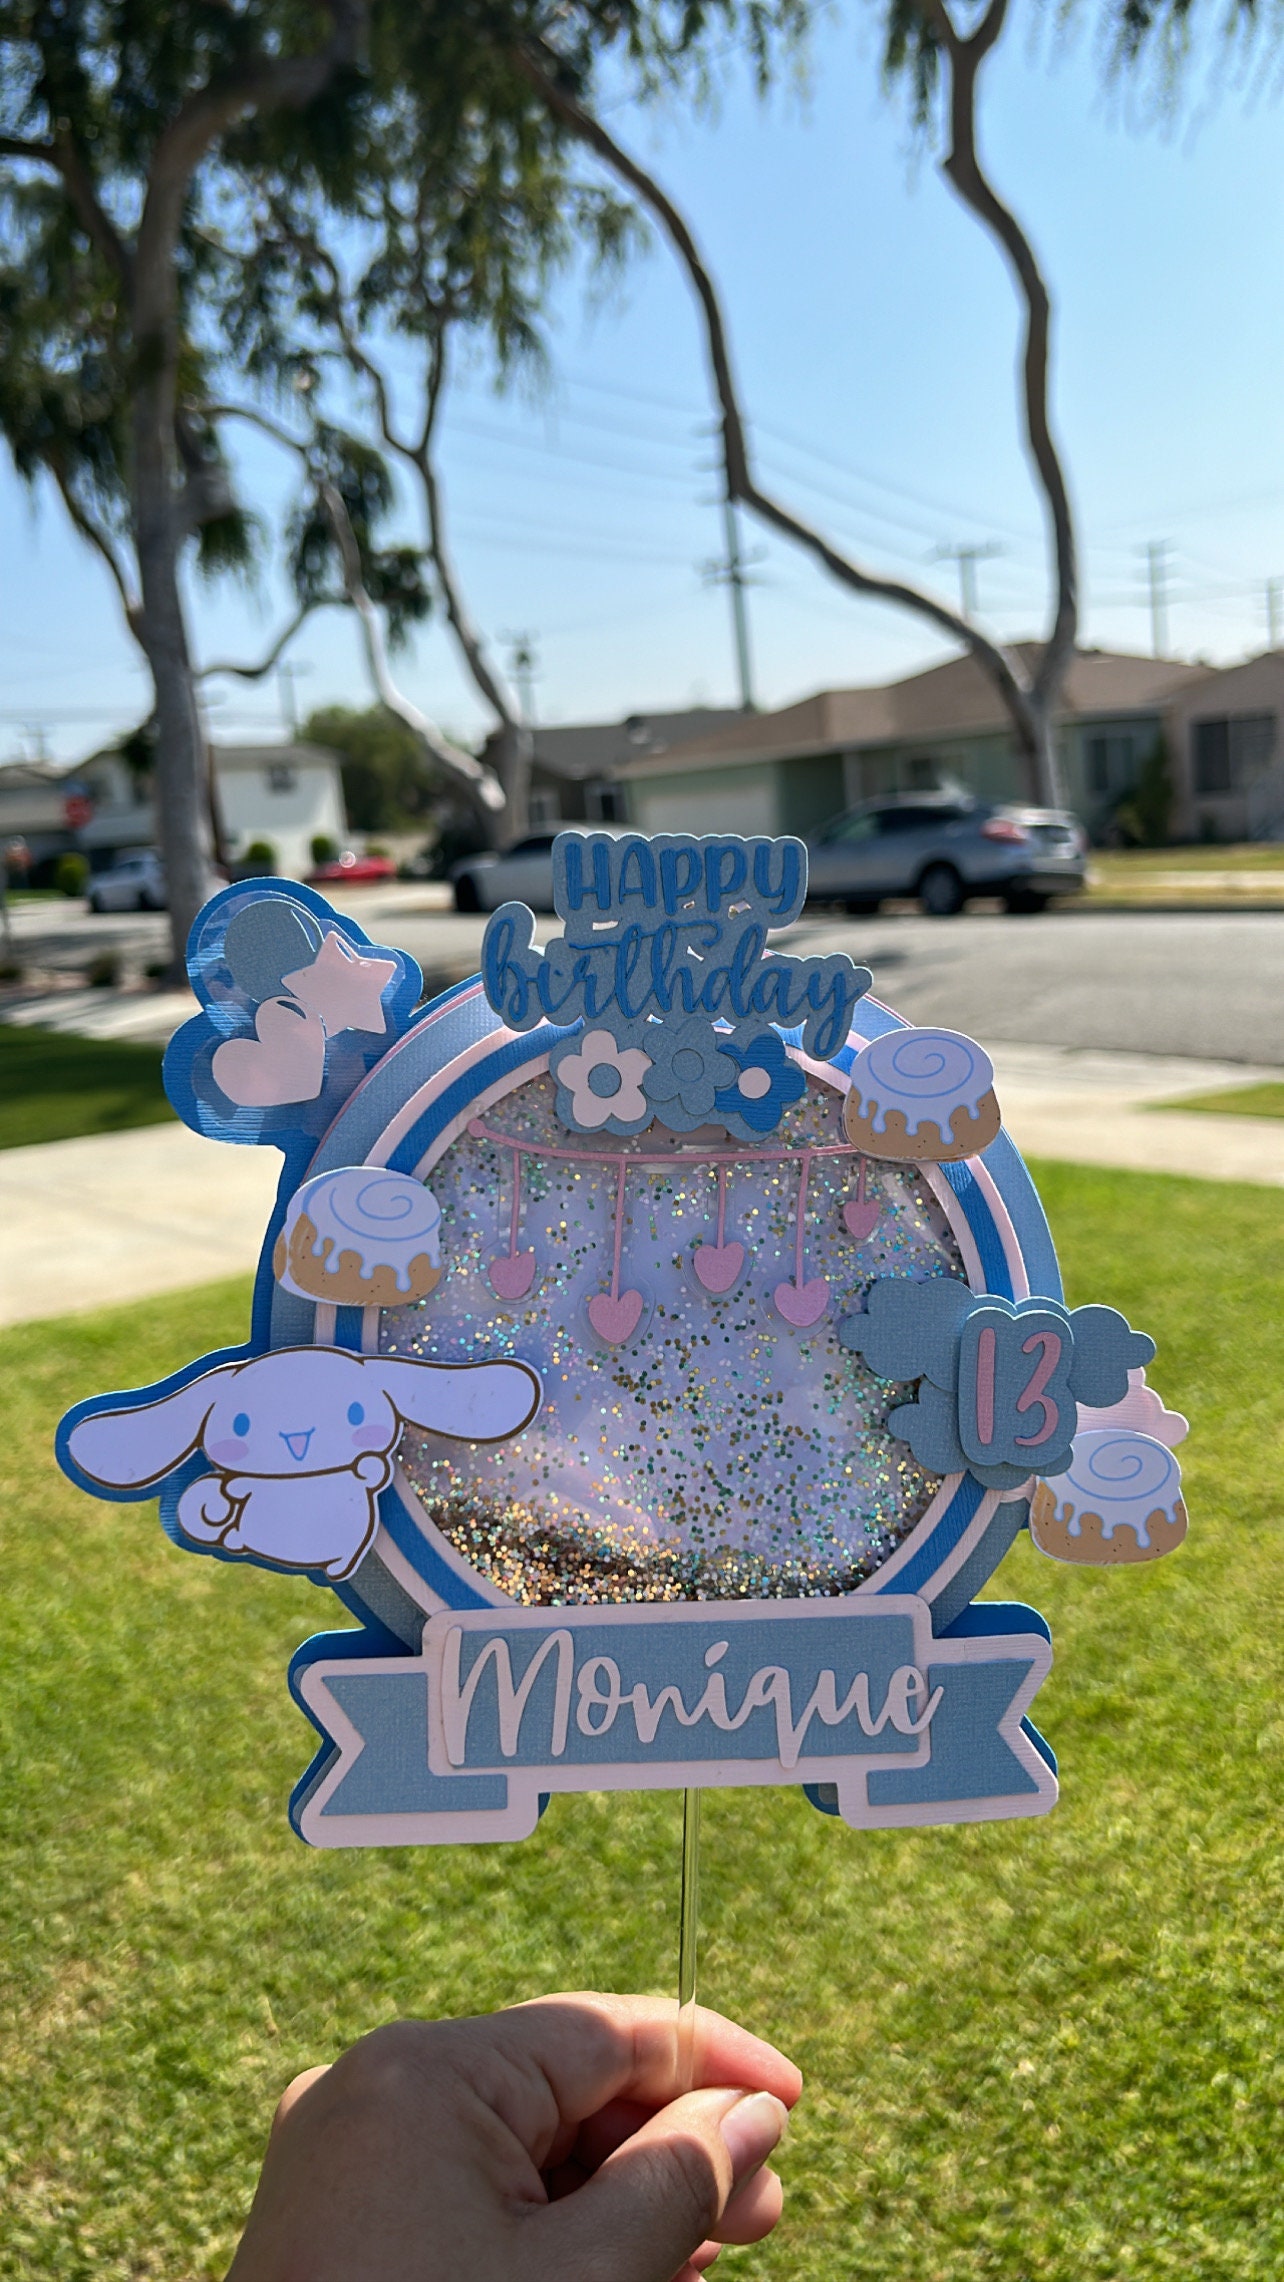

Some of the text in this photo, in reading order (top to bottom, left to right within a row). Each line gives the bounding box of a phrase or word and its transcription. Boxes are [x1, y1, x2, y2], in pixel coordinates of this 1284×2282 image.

[487, 918, 865, 1056] birthday
[976, 1327, 1062, 1446] 13
[441, 1627, 944, 1769] Monique
